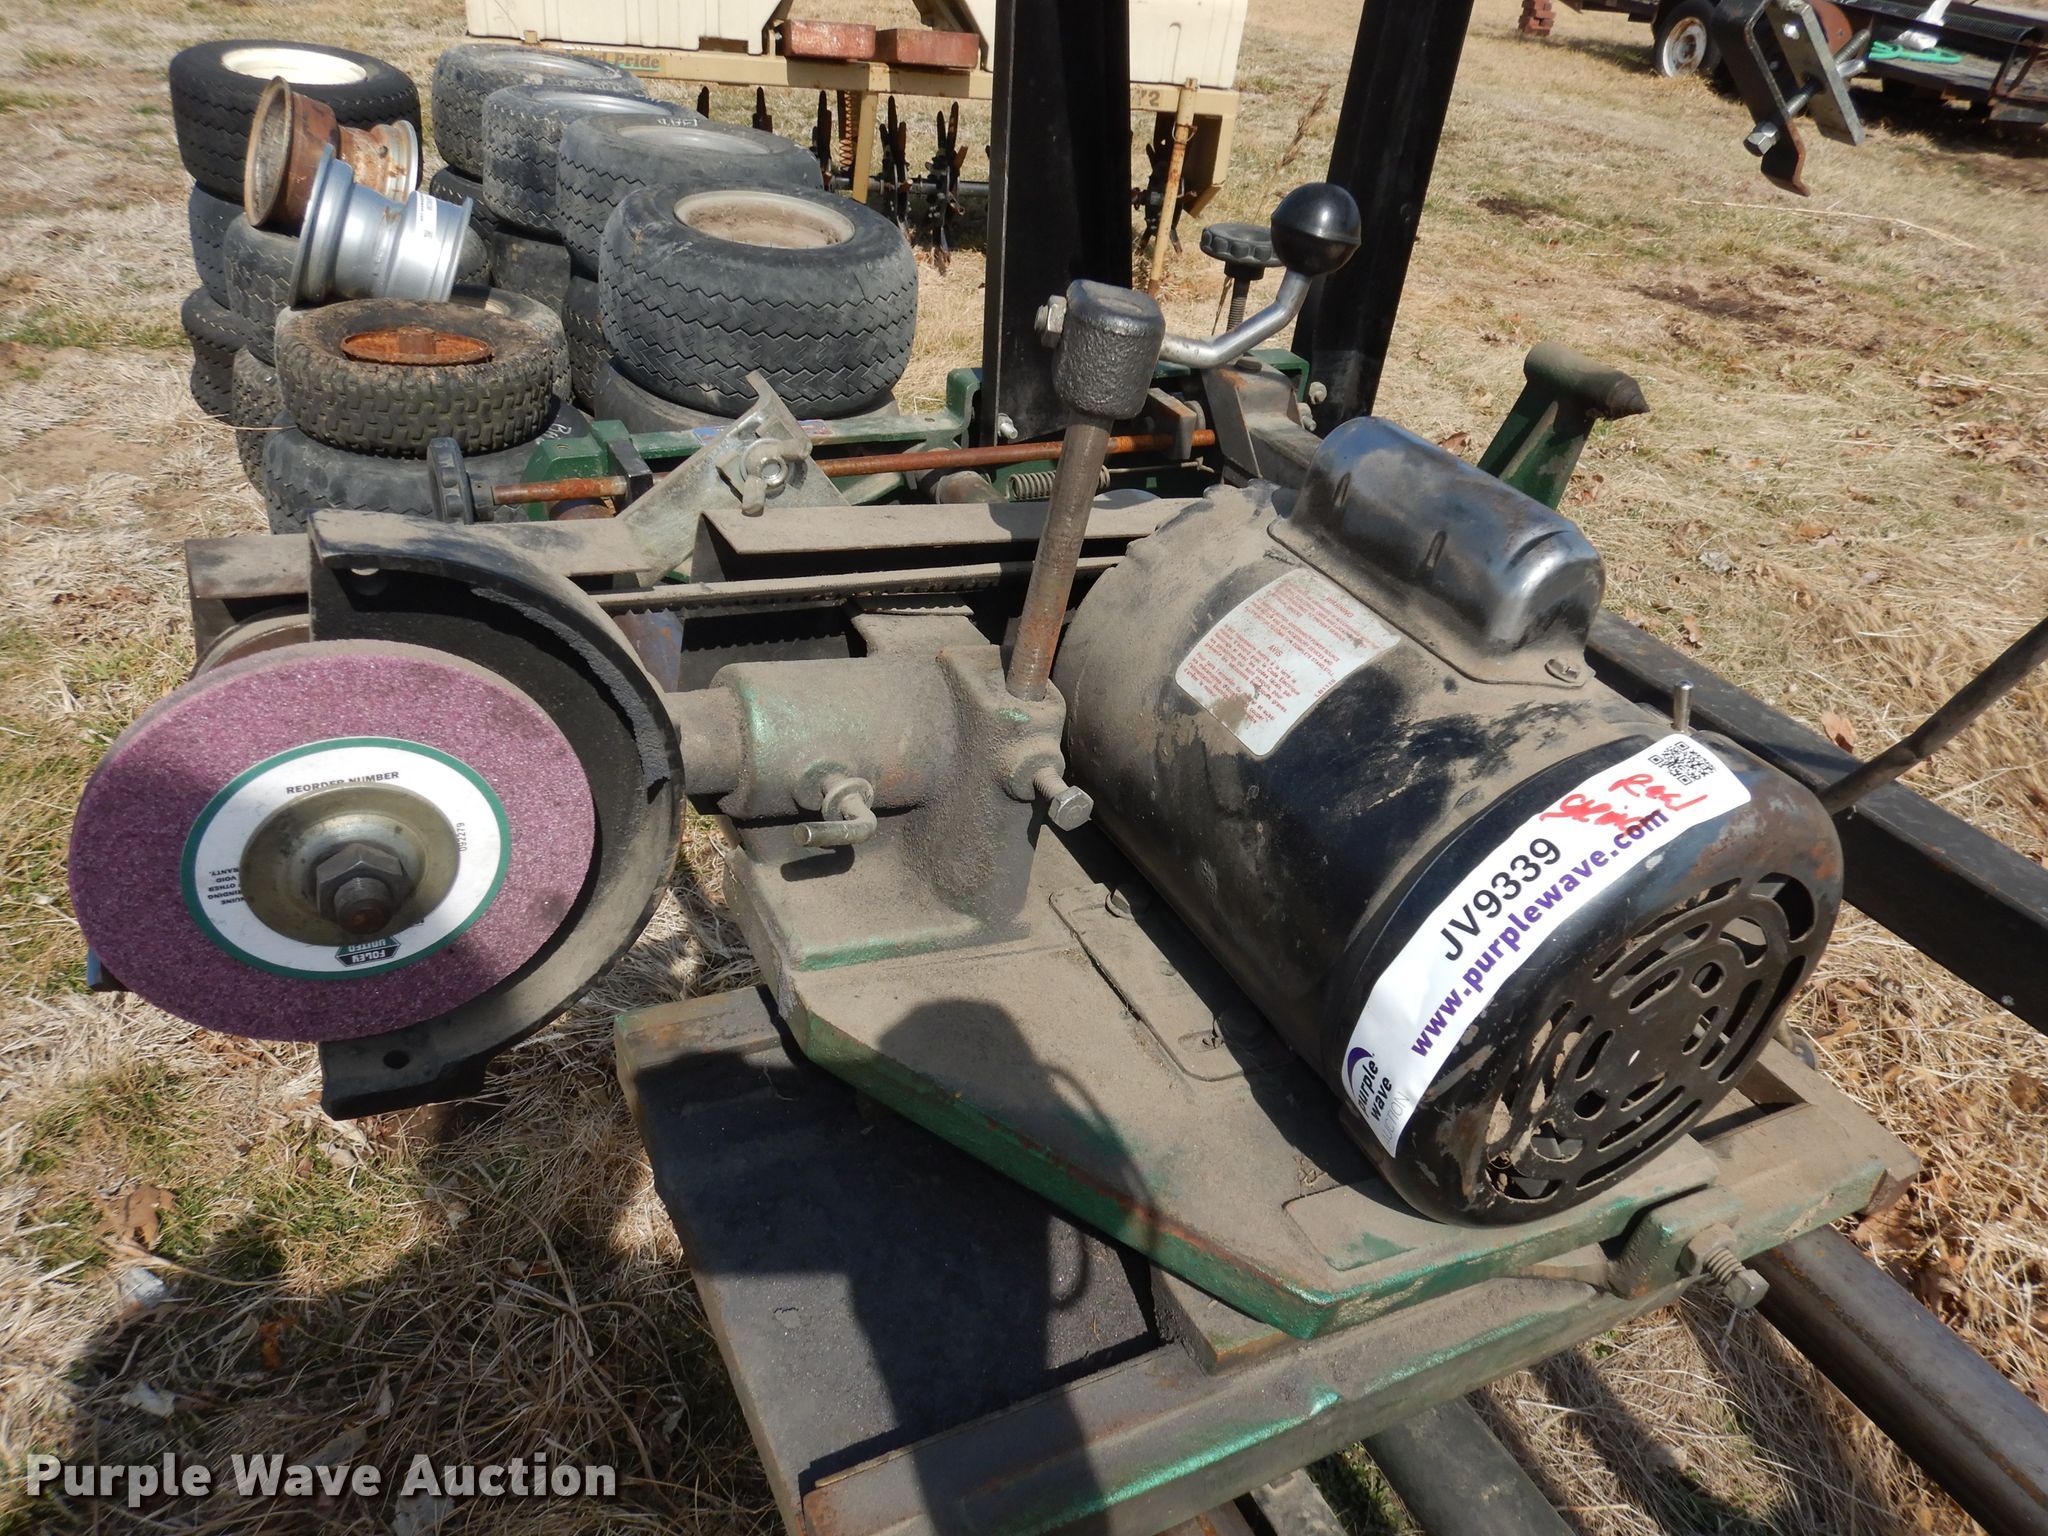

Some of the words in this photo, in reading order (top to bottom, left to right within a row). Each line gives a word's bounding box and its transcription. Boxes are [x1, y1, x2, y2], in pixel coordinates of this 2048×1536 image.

[615, 52, 660, 69] Pride
[1266, 643, 1284, 658] AVIS
[349, 770, 400, 785] NUMBER
[208, 867, 240, 877] RANTY.
[215, 875, 238, 884] VOID
[207, 882, 237, 893] OTHER
[1440, 837, 1561, 962] JV9339
[1411, 808, 1670, 1058] www.purplewave.com
[351, 949, 387, 964] FOLEY
[1357, 1060, 1379, 1118] purple
[1371, 1076, 1393, 1122] wave
